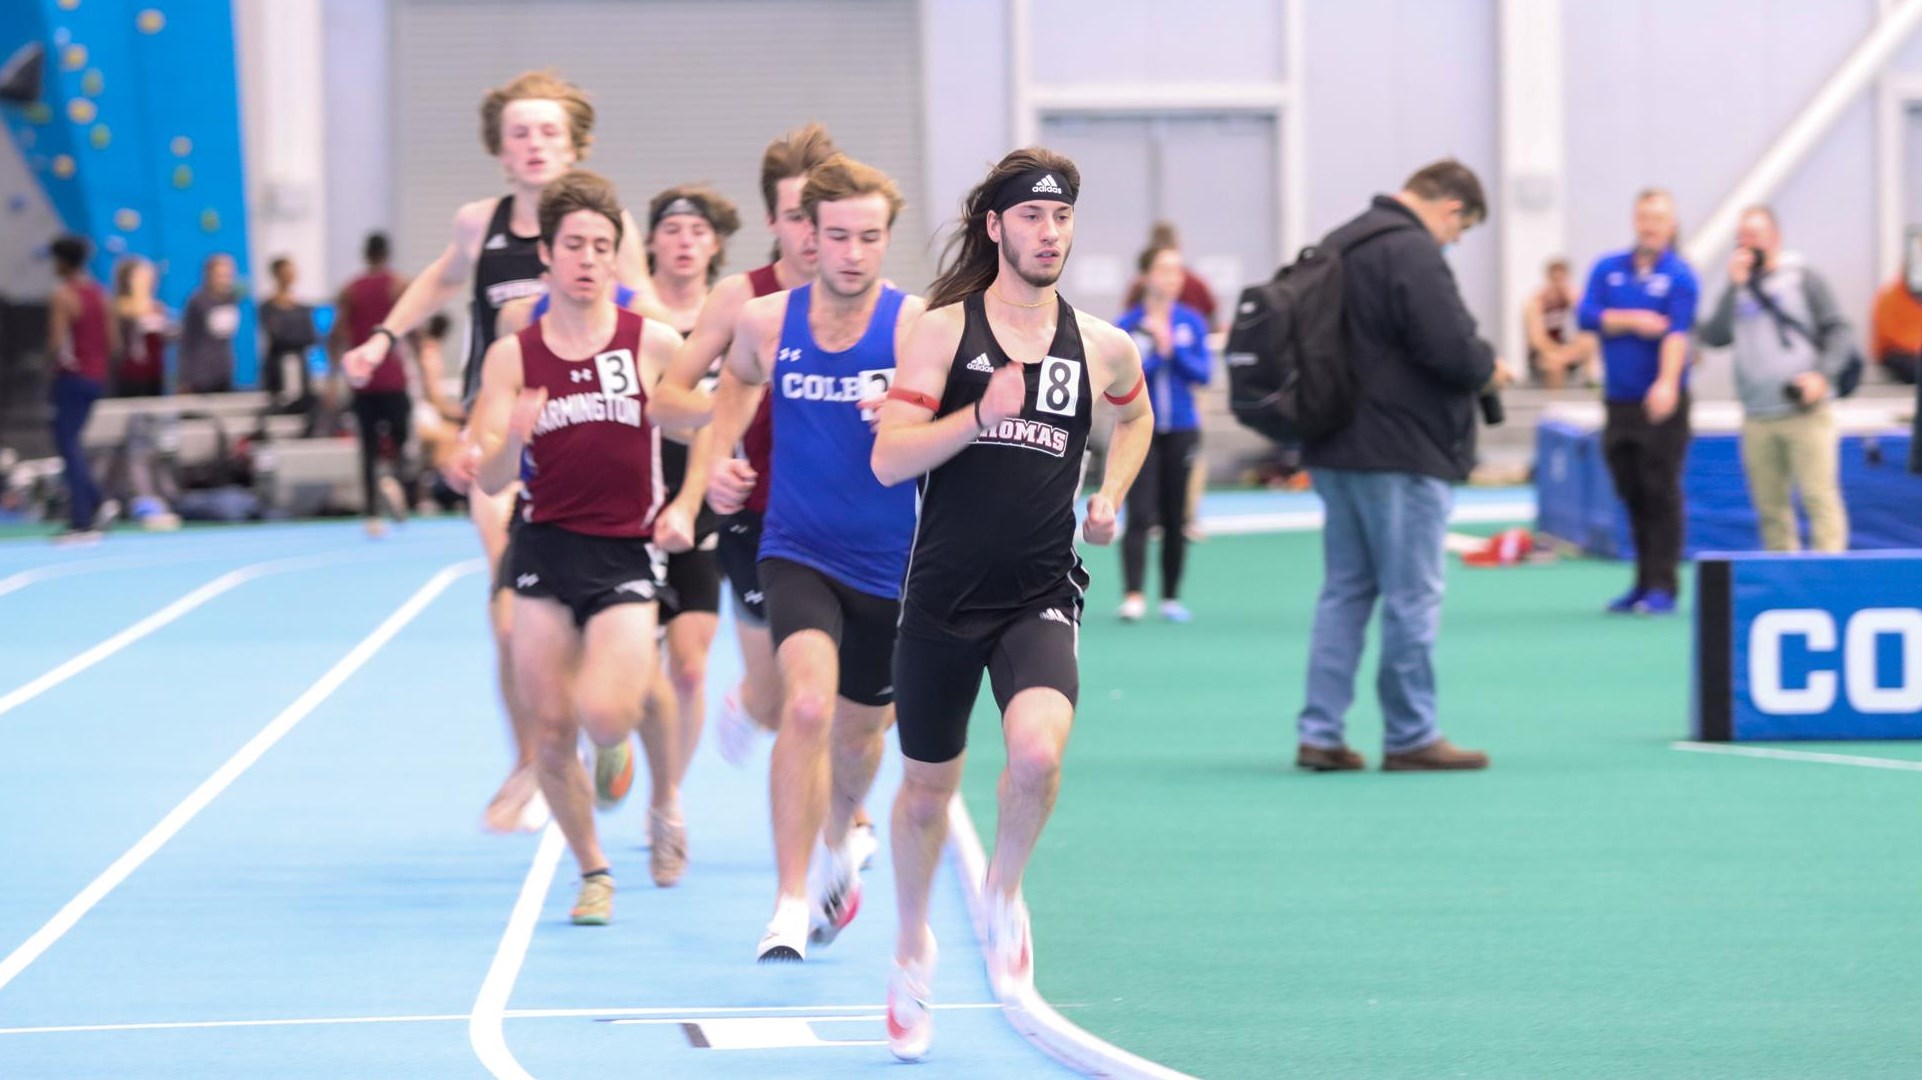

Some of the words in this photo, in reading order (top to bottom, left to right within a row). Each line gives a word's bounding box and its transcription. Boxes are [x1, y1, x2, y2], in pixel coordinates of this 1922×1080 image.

[1032, 186, 1062, 194] adidas
[606, 355, 629, 394] 3
[967, 362, 994, 373] adidas
[782, 372, 860, 402] COLB
[1046, 361, 1071, 411] 8
[532, 392, 641, 436] ARMINGTON
